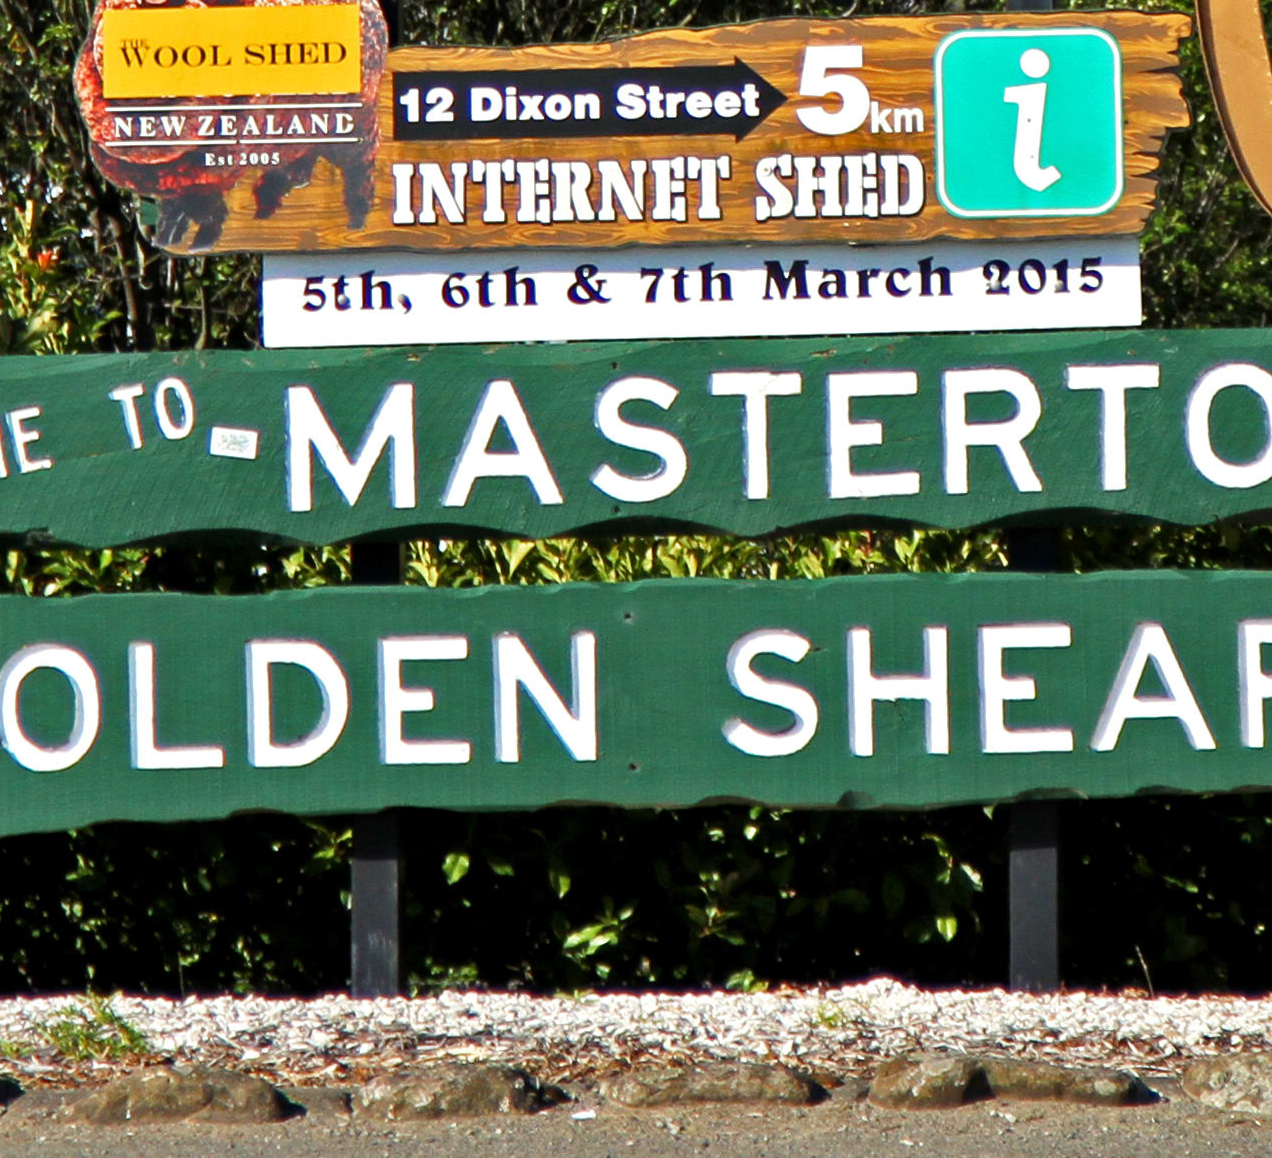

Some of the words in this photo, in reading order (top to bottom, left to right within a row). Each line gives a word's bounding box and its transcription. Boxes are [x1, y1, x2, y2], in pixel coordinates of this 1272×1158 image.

[120, 45, 232, 68] WOOL
[245, 42, 347, 66] SHED
[400, 88, 455, 123] 12
[471, 87, 600, 122] Dixon
[616, 84, 760, 120] Street
[114, 116, 186, 138] NEW
[198, 113, 355, 137] ZEALAND
[205, 153, 233, 167] Est
[239, 152, 280, 166] 2005
[391, 155, 730, 225] INTERNET
[755, 152, 925, 222] SHED
[302, 270, 412, 314] 5th,
[441, 266, 538, 308] 6th
[567, 264, 611, 305] &
[640, 262, 733, 303] 7th
[762, 256, 953, 300] March
[982, 256, 1104, 296] 2015
[108, 377, 195, 449] TO
